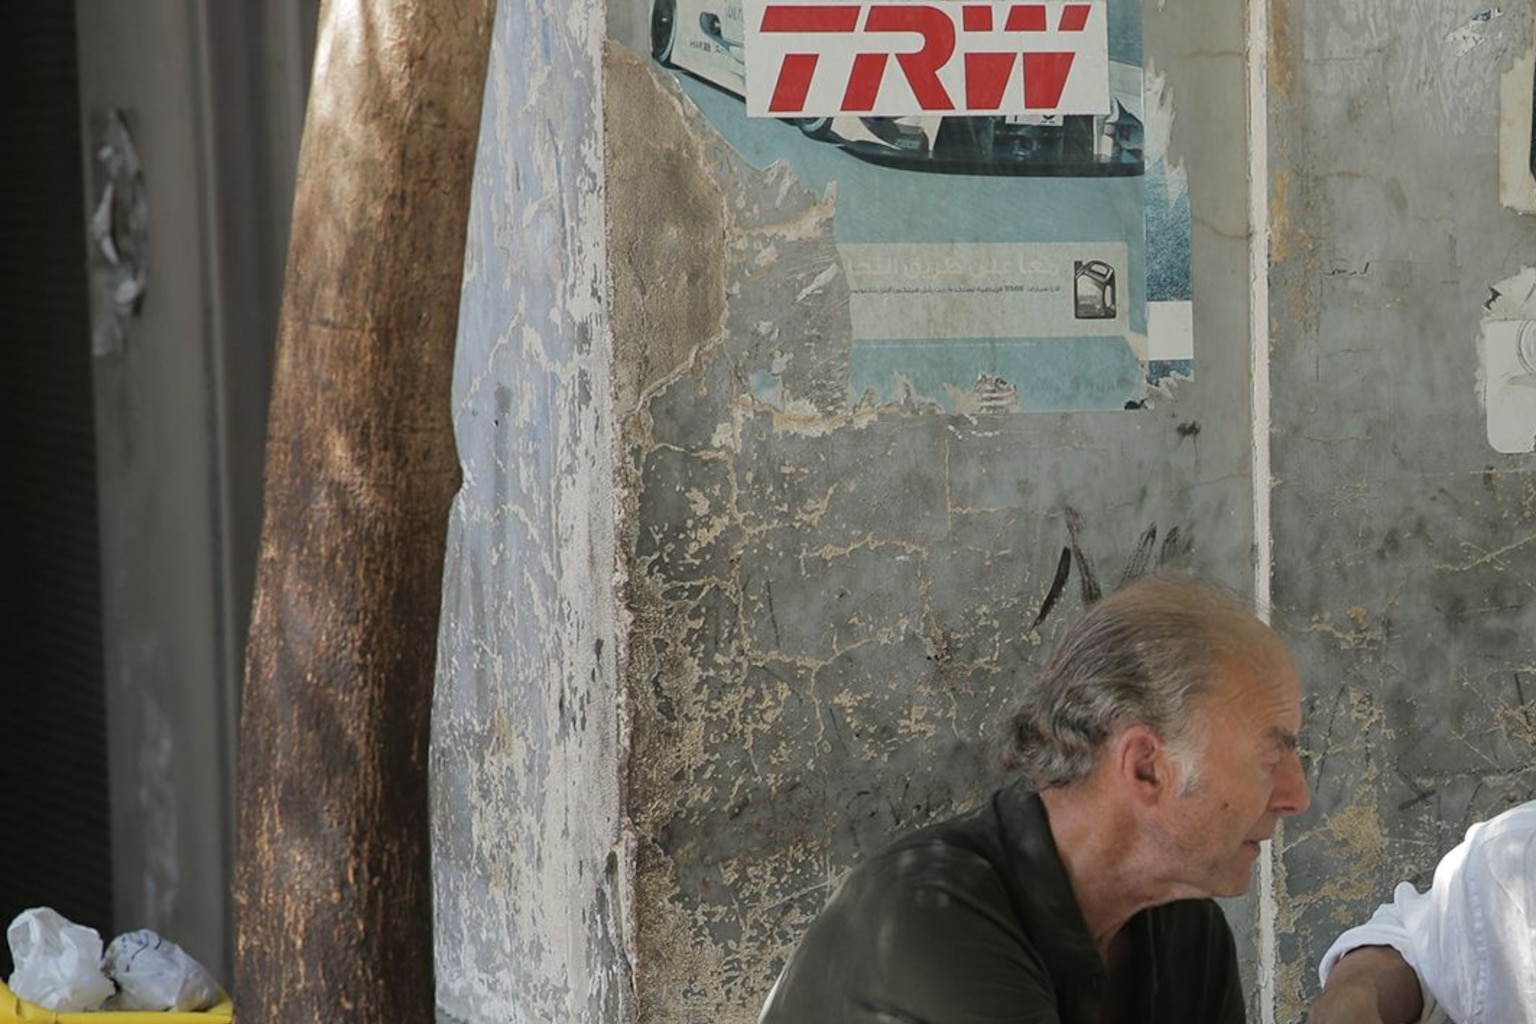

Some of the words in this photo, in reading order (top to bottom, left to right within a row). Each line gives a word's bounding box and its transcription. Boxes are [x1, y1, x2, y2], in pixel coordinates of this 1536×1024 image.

[758, 4, 1091, 112] TRW
[846, 255, 898, 275] النجا
[903, 256, 964, 279] طريق
[1017, 253, 1061, 276] معا
